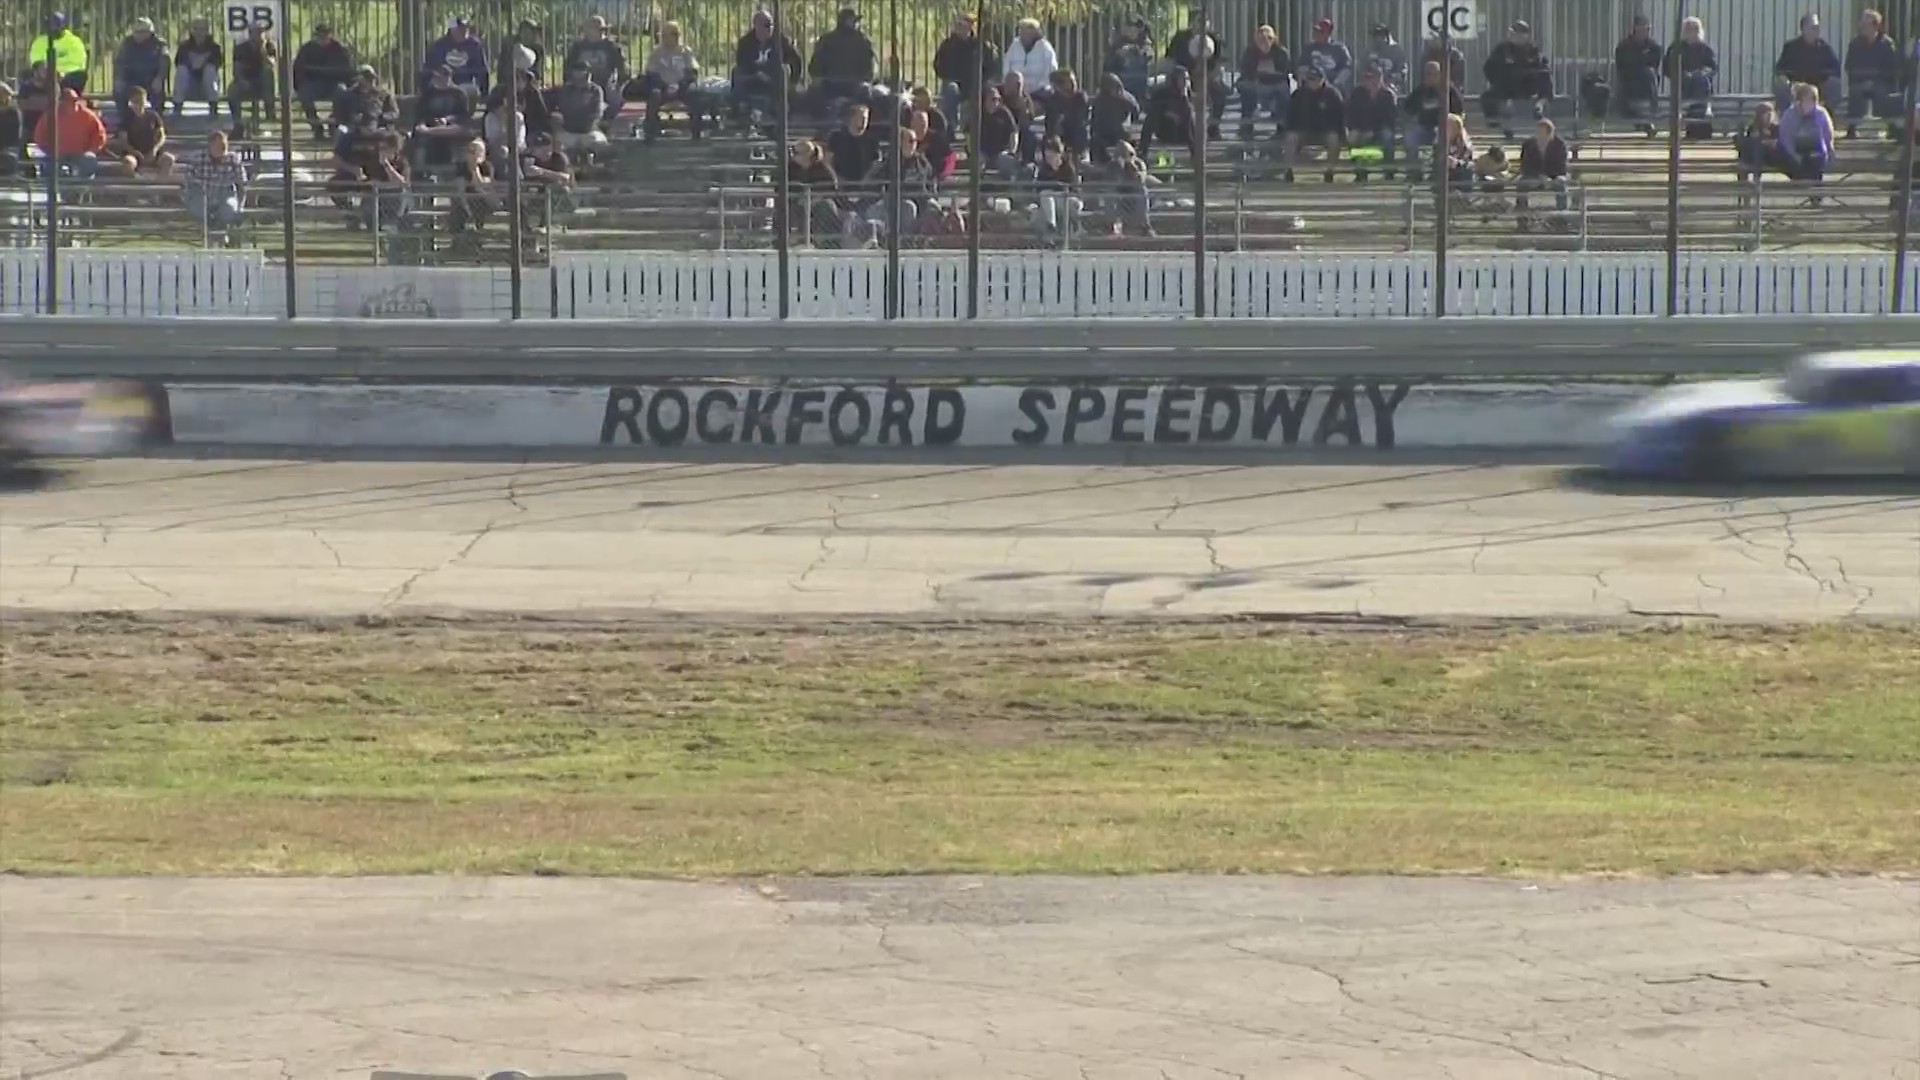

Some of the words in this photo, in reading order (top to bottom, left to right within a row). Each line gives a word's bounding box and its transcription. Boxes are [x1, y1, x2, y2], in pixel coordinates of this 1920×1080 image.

[228, 6, 273, 31] BB
[600, 384, 966, 447] ROCKFORD
[1011, 384, 1411, 448] SPEEDWAY
